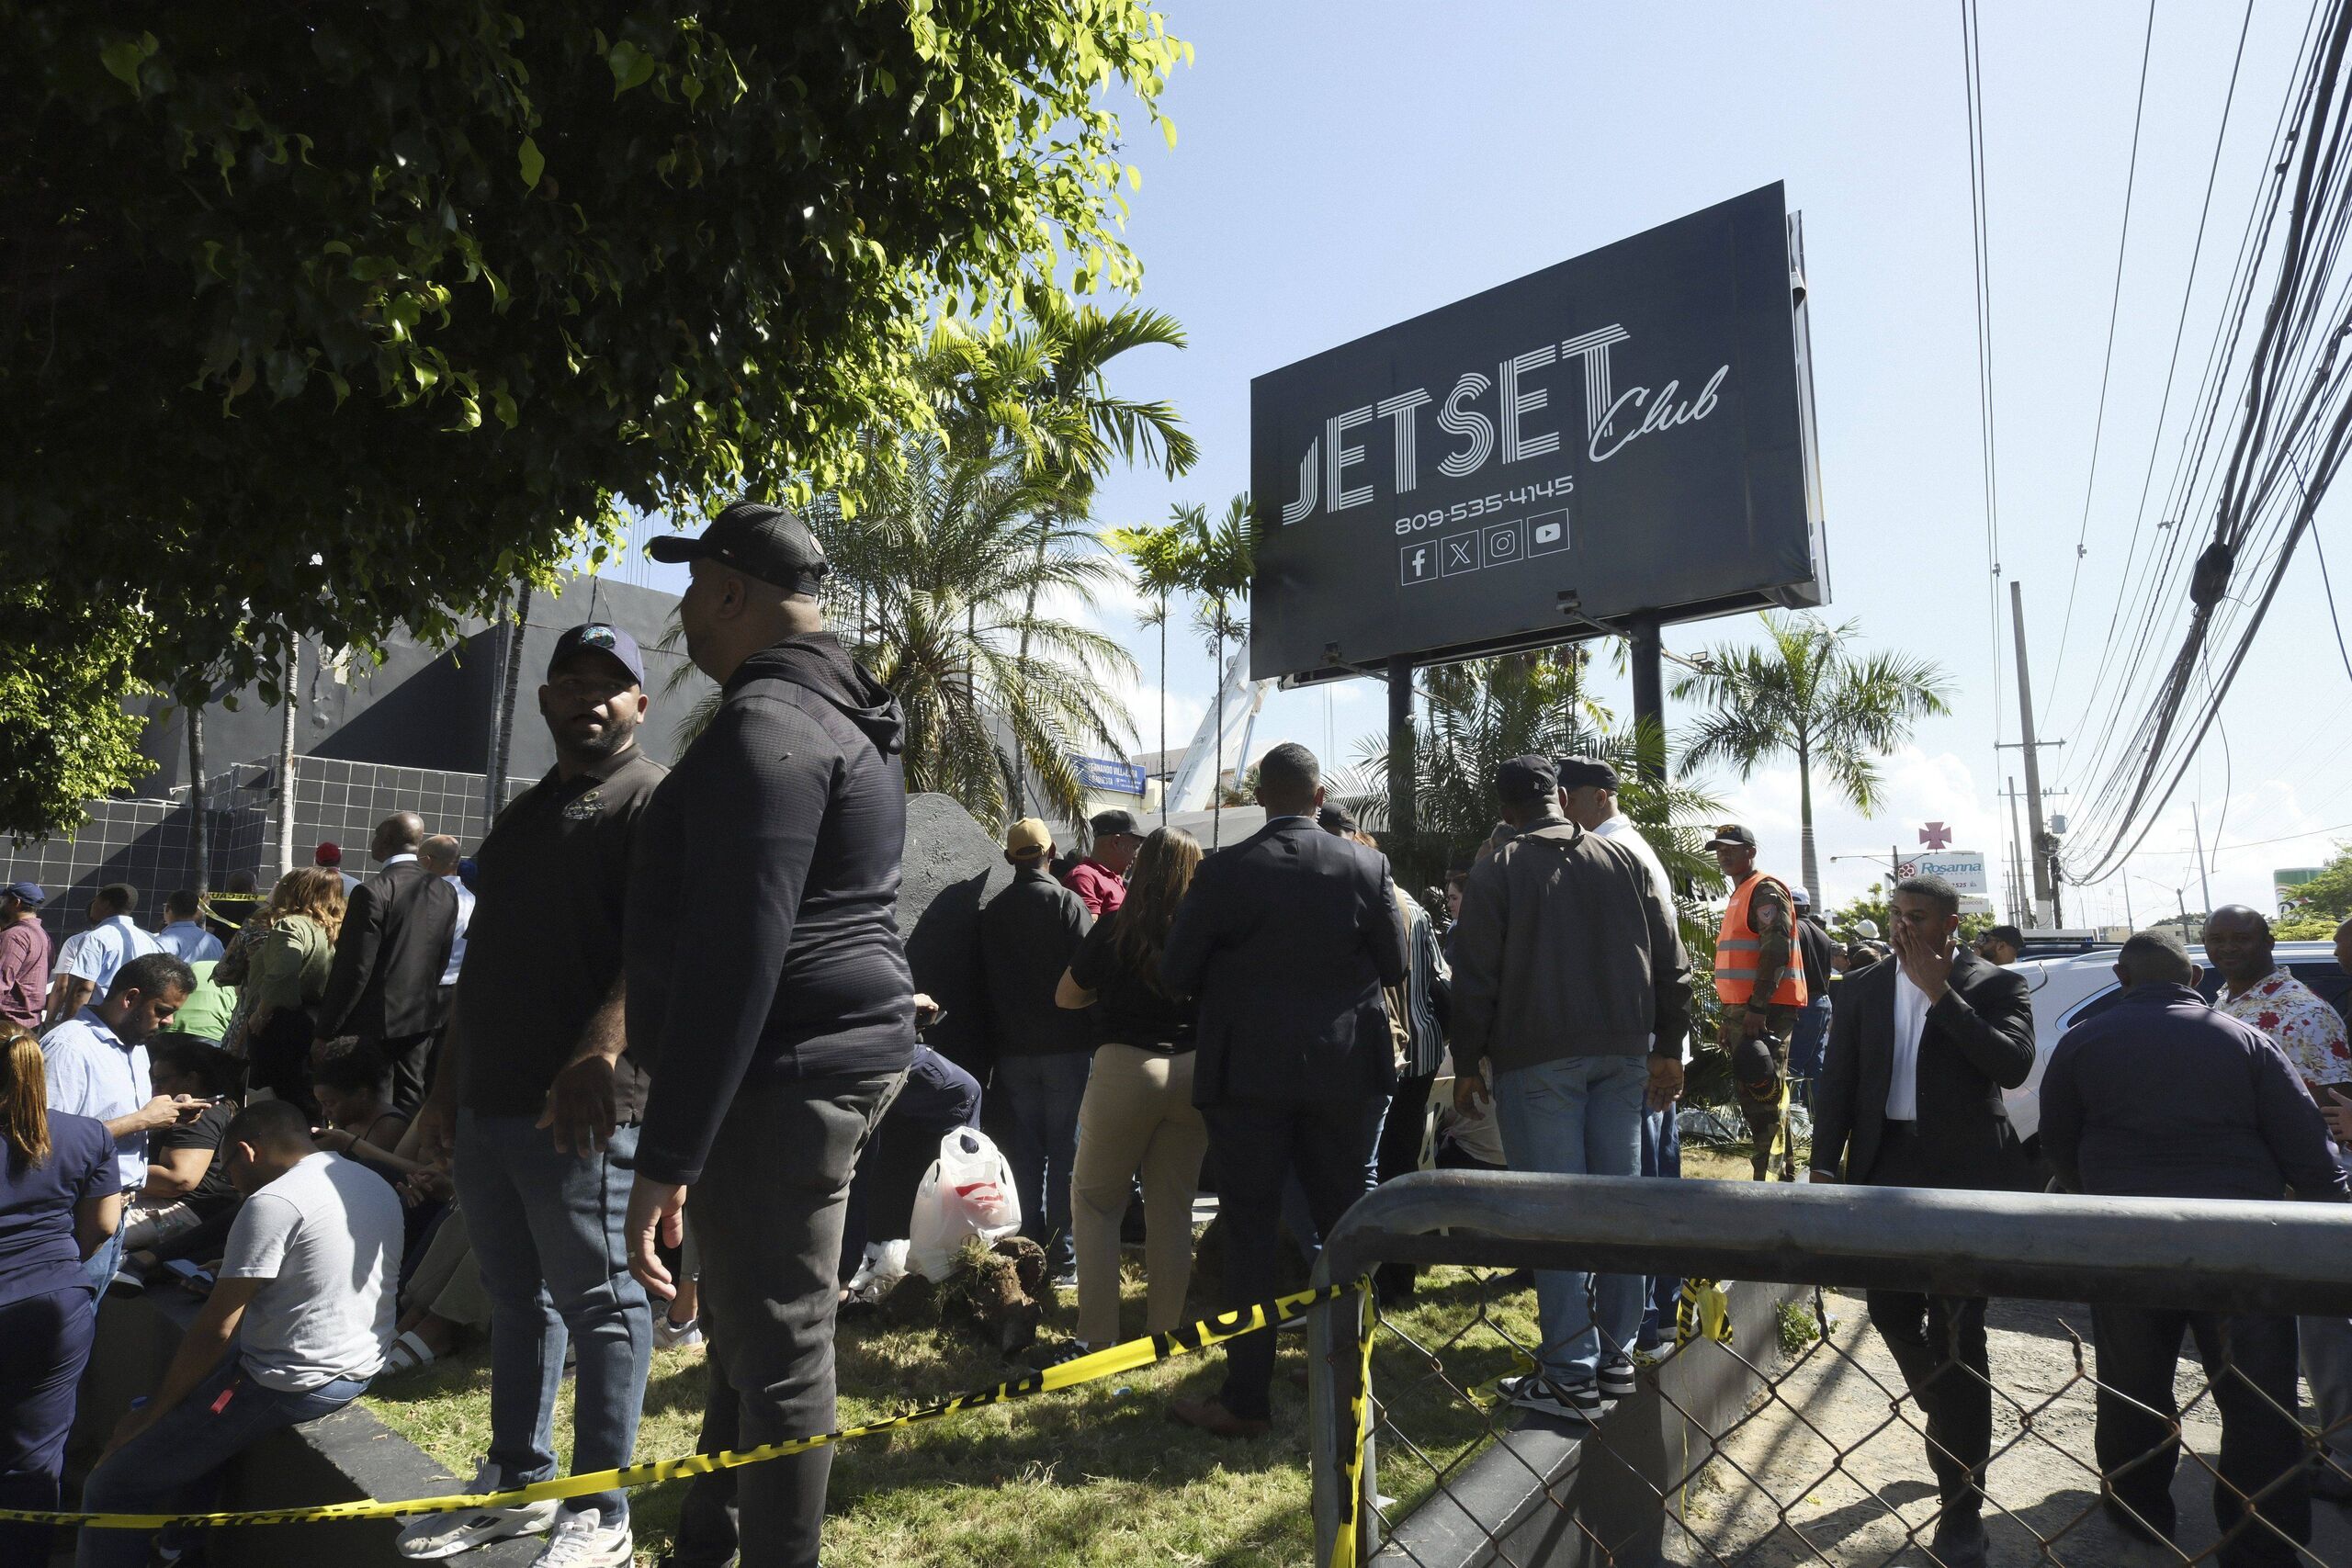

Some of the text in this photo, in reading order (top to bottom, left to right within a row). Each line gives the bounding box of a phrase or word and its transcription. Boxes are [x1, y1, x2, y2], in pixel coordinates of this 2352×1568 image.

[1282, 322, 1730, 526] JETSET Club
[1395, 474, 1575, 536] 809-535-4145
[1921, 862, 1983, 874] Rosanna
